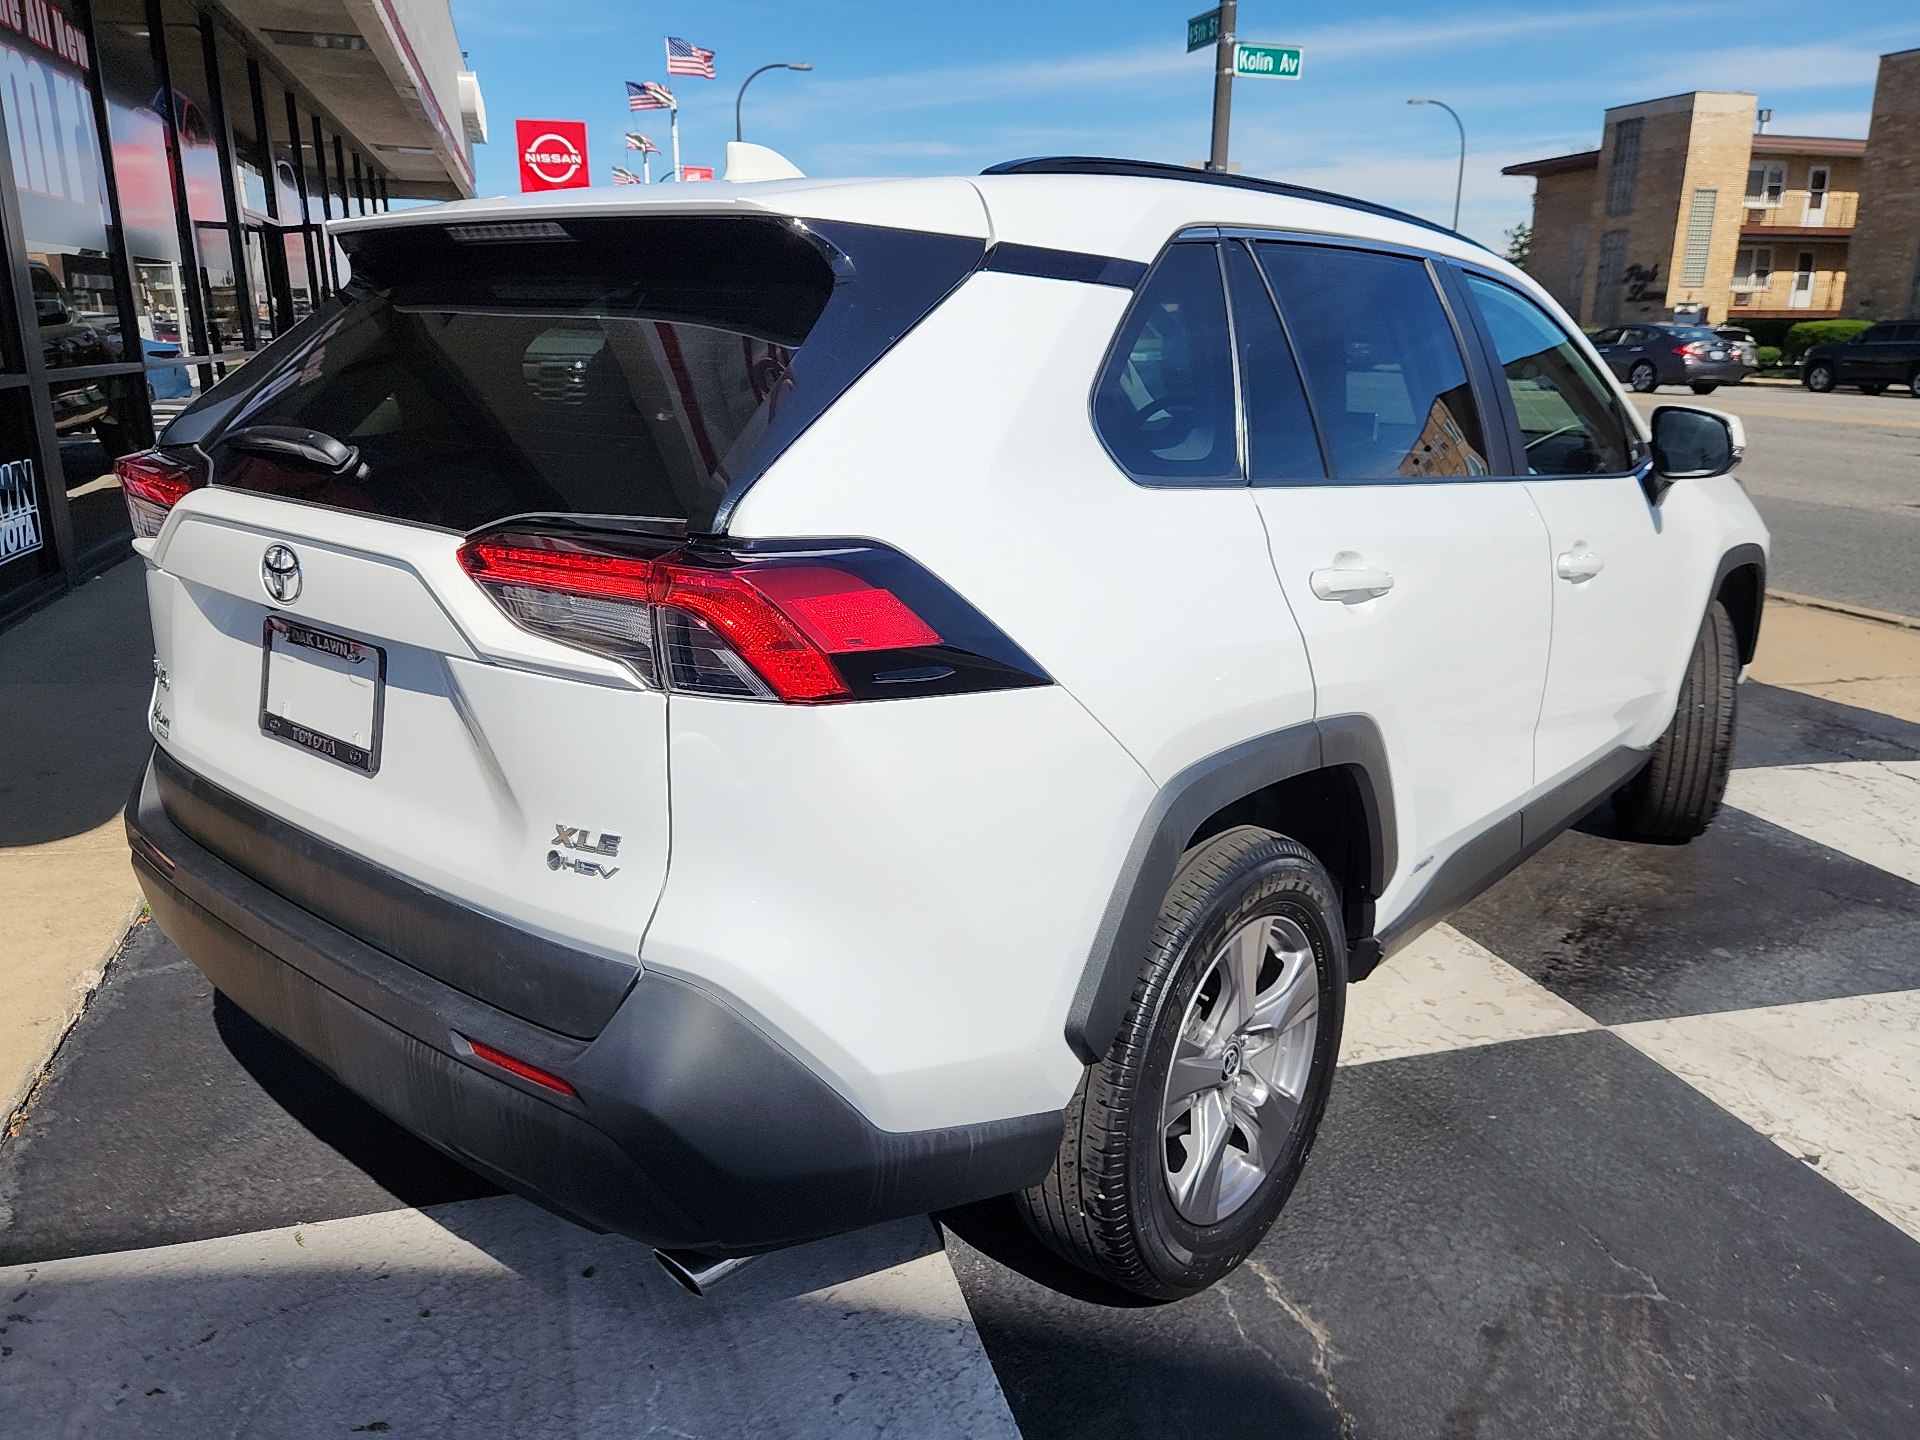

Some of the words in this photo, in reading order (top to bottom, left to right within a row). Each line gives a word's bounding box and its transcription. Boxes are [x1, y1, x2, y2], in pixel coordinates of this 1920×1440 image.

[25, 0, 53, 50] All
[52, 7, 90, 70] New
[1239, 49, 1273, 72] Kolin
[1280, 53, 1298, 73] Av
[524, 153, 582, 165] NISSAN
[292, 628, 315, 646] OAK
[316, 635, 348, 656] LAWN
[292, 726, 336, 756] TOYOTA
[551, 824, 622, 857] XLE
